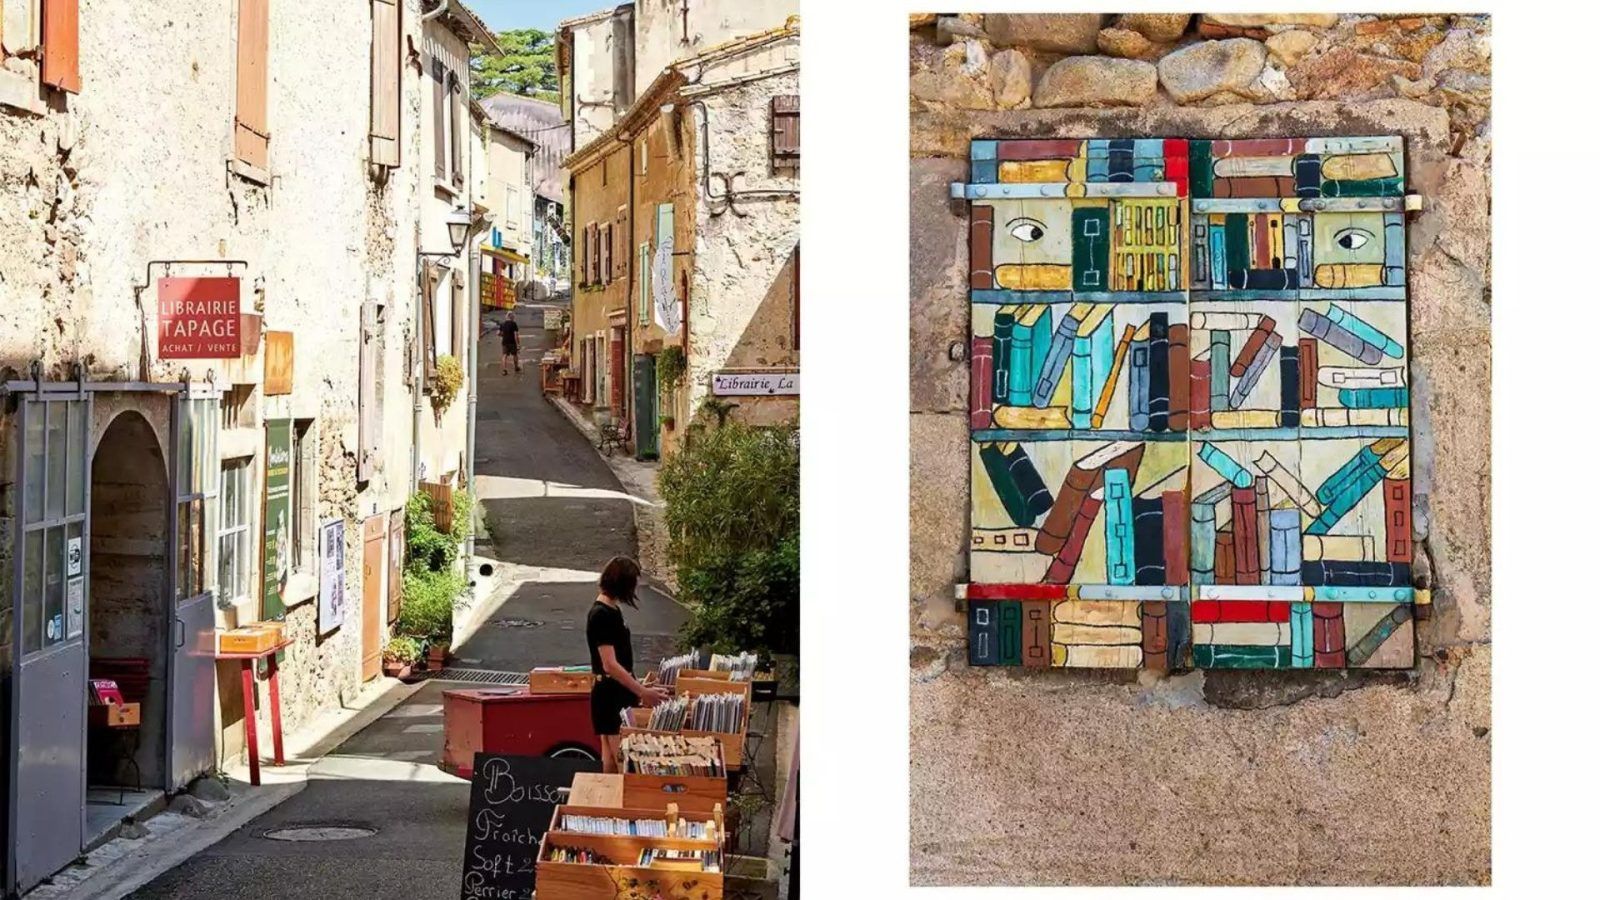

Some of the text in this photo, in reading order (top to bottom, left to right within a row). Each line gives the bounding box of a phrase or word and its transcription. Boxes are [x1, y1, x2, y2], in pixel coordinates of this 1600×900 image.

[161, 300, 236, 316] LIBRAIRIE
[162, 319, 236, 338] TAPAGE
[162, 344, 193, 353] ACHAT
[207, 343, 237, 353] VENTE
[719, 377, 794, 390] Librairie La
[471, 845, 514, 879] Soft
[464, 871, 516, 899] Perrier
